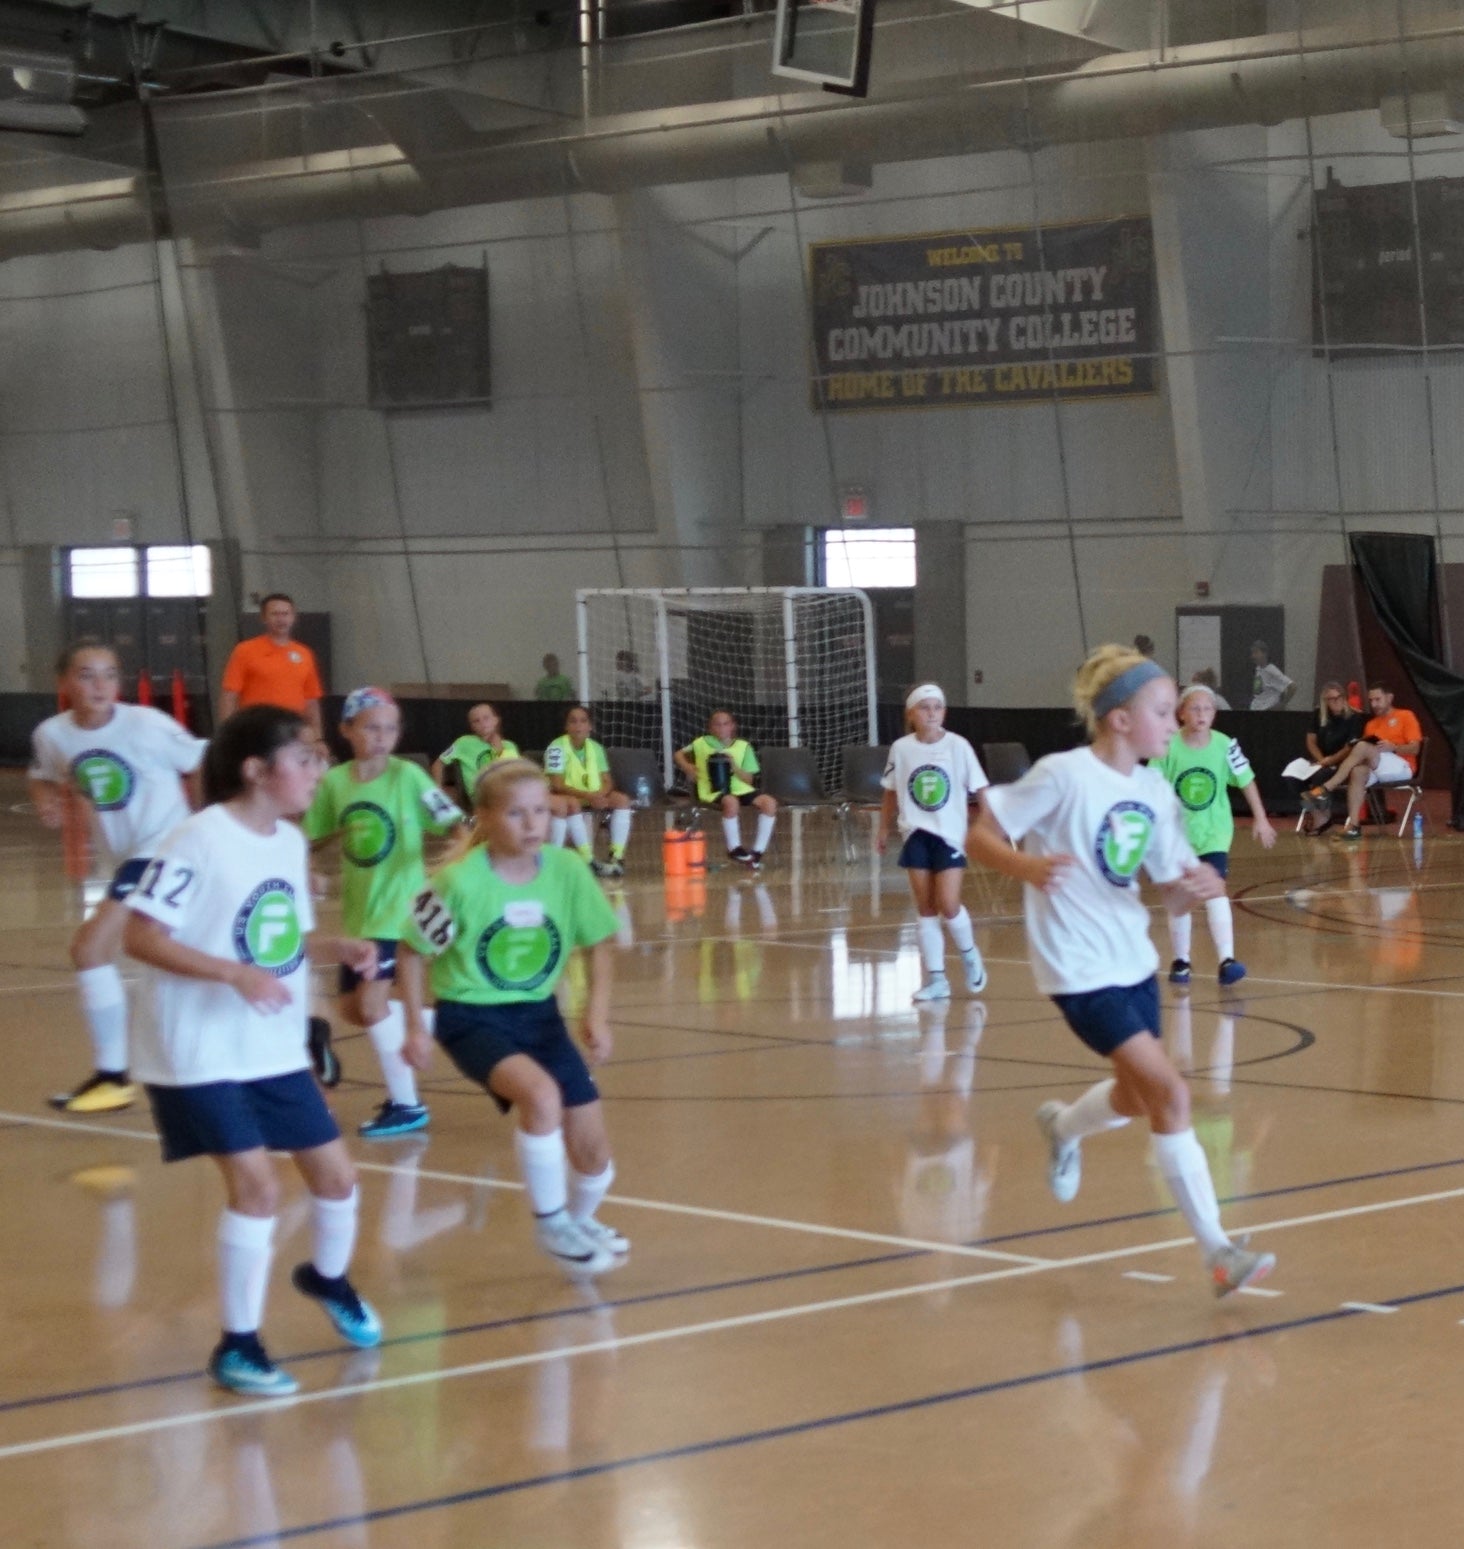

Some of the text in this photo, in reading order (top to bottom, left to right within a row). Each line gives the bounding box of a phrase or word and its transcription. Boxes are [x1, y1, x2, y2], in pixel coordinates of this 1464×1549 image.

[927, 242, 1023, 267] WELCOME TO
[852, 266, 1107, 318] JOHNSON COUNTY
[828, 307, 1136, 361] COMMUNITY COLLEGE
[828, 357, 1134, 400] HOME OF THE CAVALIERS
[142, 860, 194, 908] 12
[258, 904, 289, 953] F
